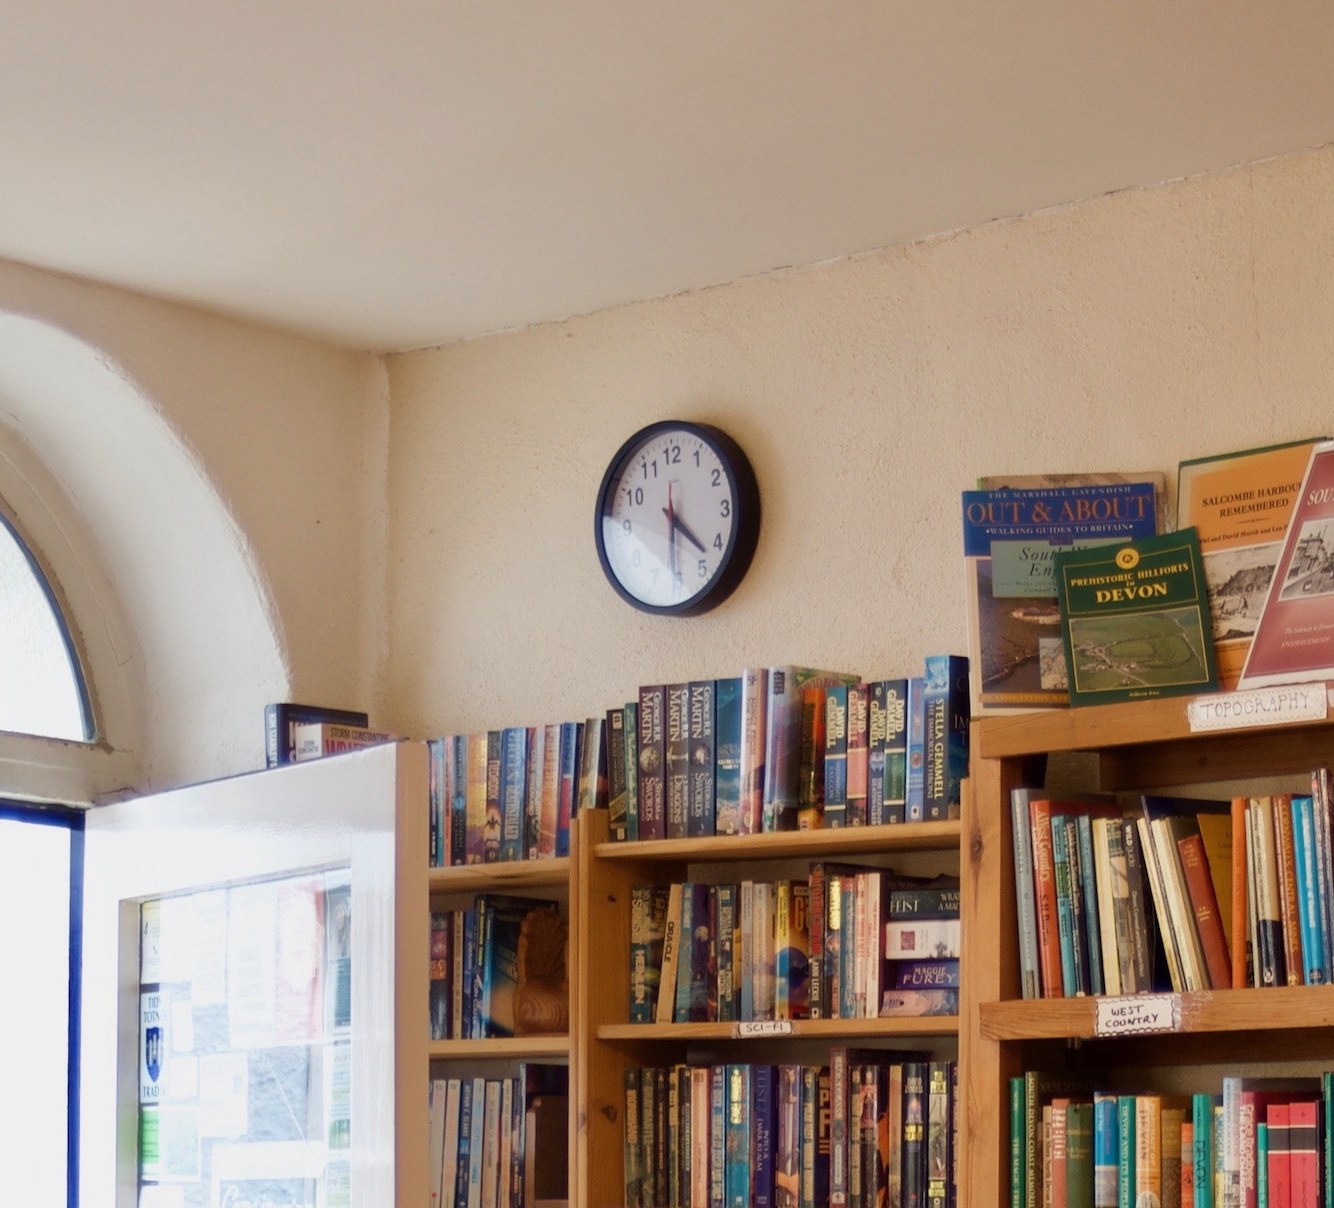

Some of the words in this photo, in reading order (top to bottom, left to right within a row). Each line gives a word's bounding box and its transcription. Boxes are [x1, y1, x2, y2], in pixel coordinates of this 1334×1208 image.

[663, 446, 681, 465] 12
[693, 450, 700, 467] 1
[641, 460, 657, 480] 11
[711, 469, 721, 487] 2
[626, 488, 643, 506] 10
[1202, 490, 1255, 507] SALCOMBE
[1258, 482, 1302, 499] HARBOU
[720, 500, 730, 518] 3
[967, 501, 1025, 524] OUT
[1032, 502, 1051, 523] &
[1059, 495, 1151, 521] ABOUT
[1220, 498, 1289, 518] REMEMBERED
[623, 520, 632, 537] 9
[1035, 526, 1072, 534] GUIDES
[1074, 526, 1088, 534] TO
[713, 533, 723, 551] 4
[698, 560, 707, 577] 5
[1071, 573, 1133, 587] PREHISTORIC
[1138, 563, 1189, 579] HILLFORTS
[1096, 583, 1168, 603] DEVON
[1200, 691, 1310, 719] TOPOGRAPHY
[935, 698, 944, 740] STELLA
[934, 742, 944, 799] GEMMELL
[903, 972, 957, 986] FUREY
[913, 965, 947, 977] MAGGIE
[1111, 1005, 1144, 1017] WEST
[746, 1023, 784, 1033] SCI-FI
[1105, 1013, 1159, 1028] COUNTRY
